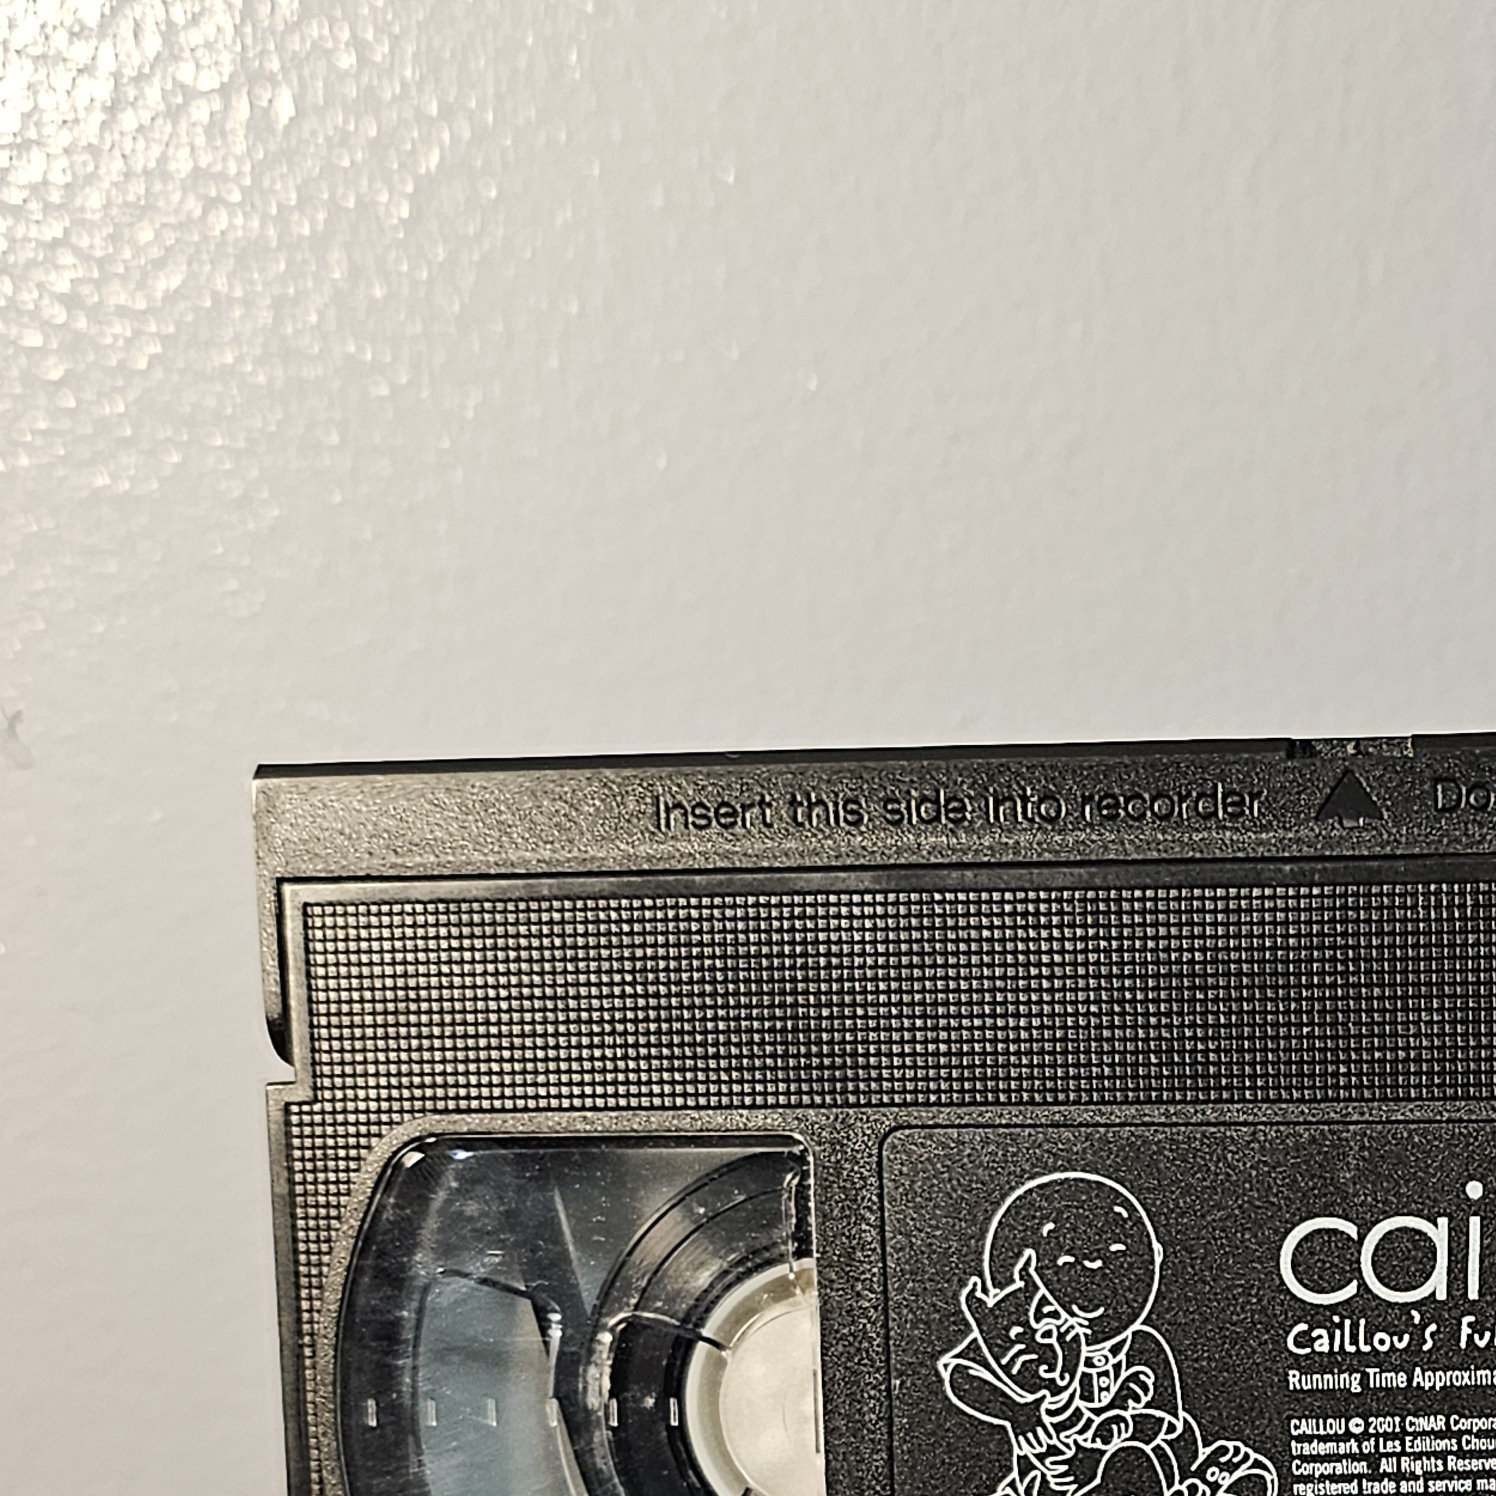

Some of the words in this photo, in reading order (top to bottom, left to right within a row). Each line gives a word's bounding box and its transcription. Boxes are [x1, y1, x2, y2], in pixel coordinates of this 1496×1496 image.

[654, 788, 773, 831] Insert
[793, 791, 866, 829] this
[882, 788, 972, 827] side
[986, 786, 1066, 824] into
[1081, 781, 1268, 823] recorder
[1434, 778, 1495, 812] Do
[1287, 1309, 1438, 1355] Caillou's
[1288, 1367, 1362, 1393] Running
[1365, 1366, 1408, 1388] Time
[1290, 1418, 1345, 1435] CAILLOU
[1405, 1415, 1446, 1432] CINAR
[1291, 1437, 1359, 1456] trademark
[1362, 1437, 1375, 1454] of
[1379, 1437, 1401, 1453] Les
[1405, 1435, 1458, 1452] Editions
[1291, 1458, 1372, 1478] Corporation.
[1379, 1457, 1397, 1474] All
[1401, 1456, 1444, 1476] Rights
[1362, 1478, 1397, 1495] trade
[1400, 1476, 1424, 1494] and
[1428, 1475, 1472, 1492] service
